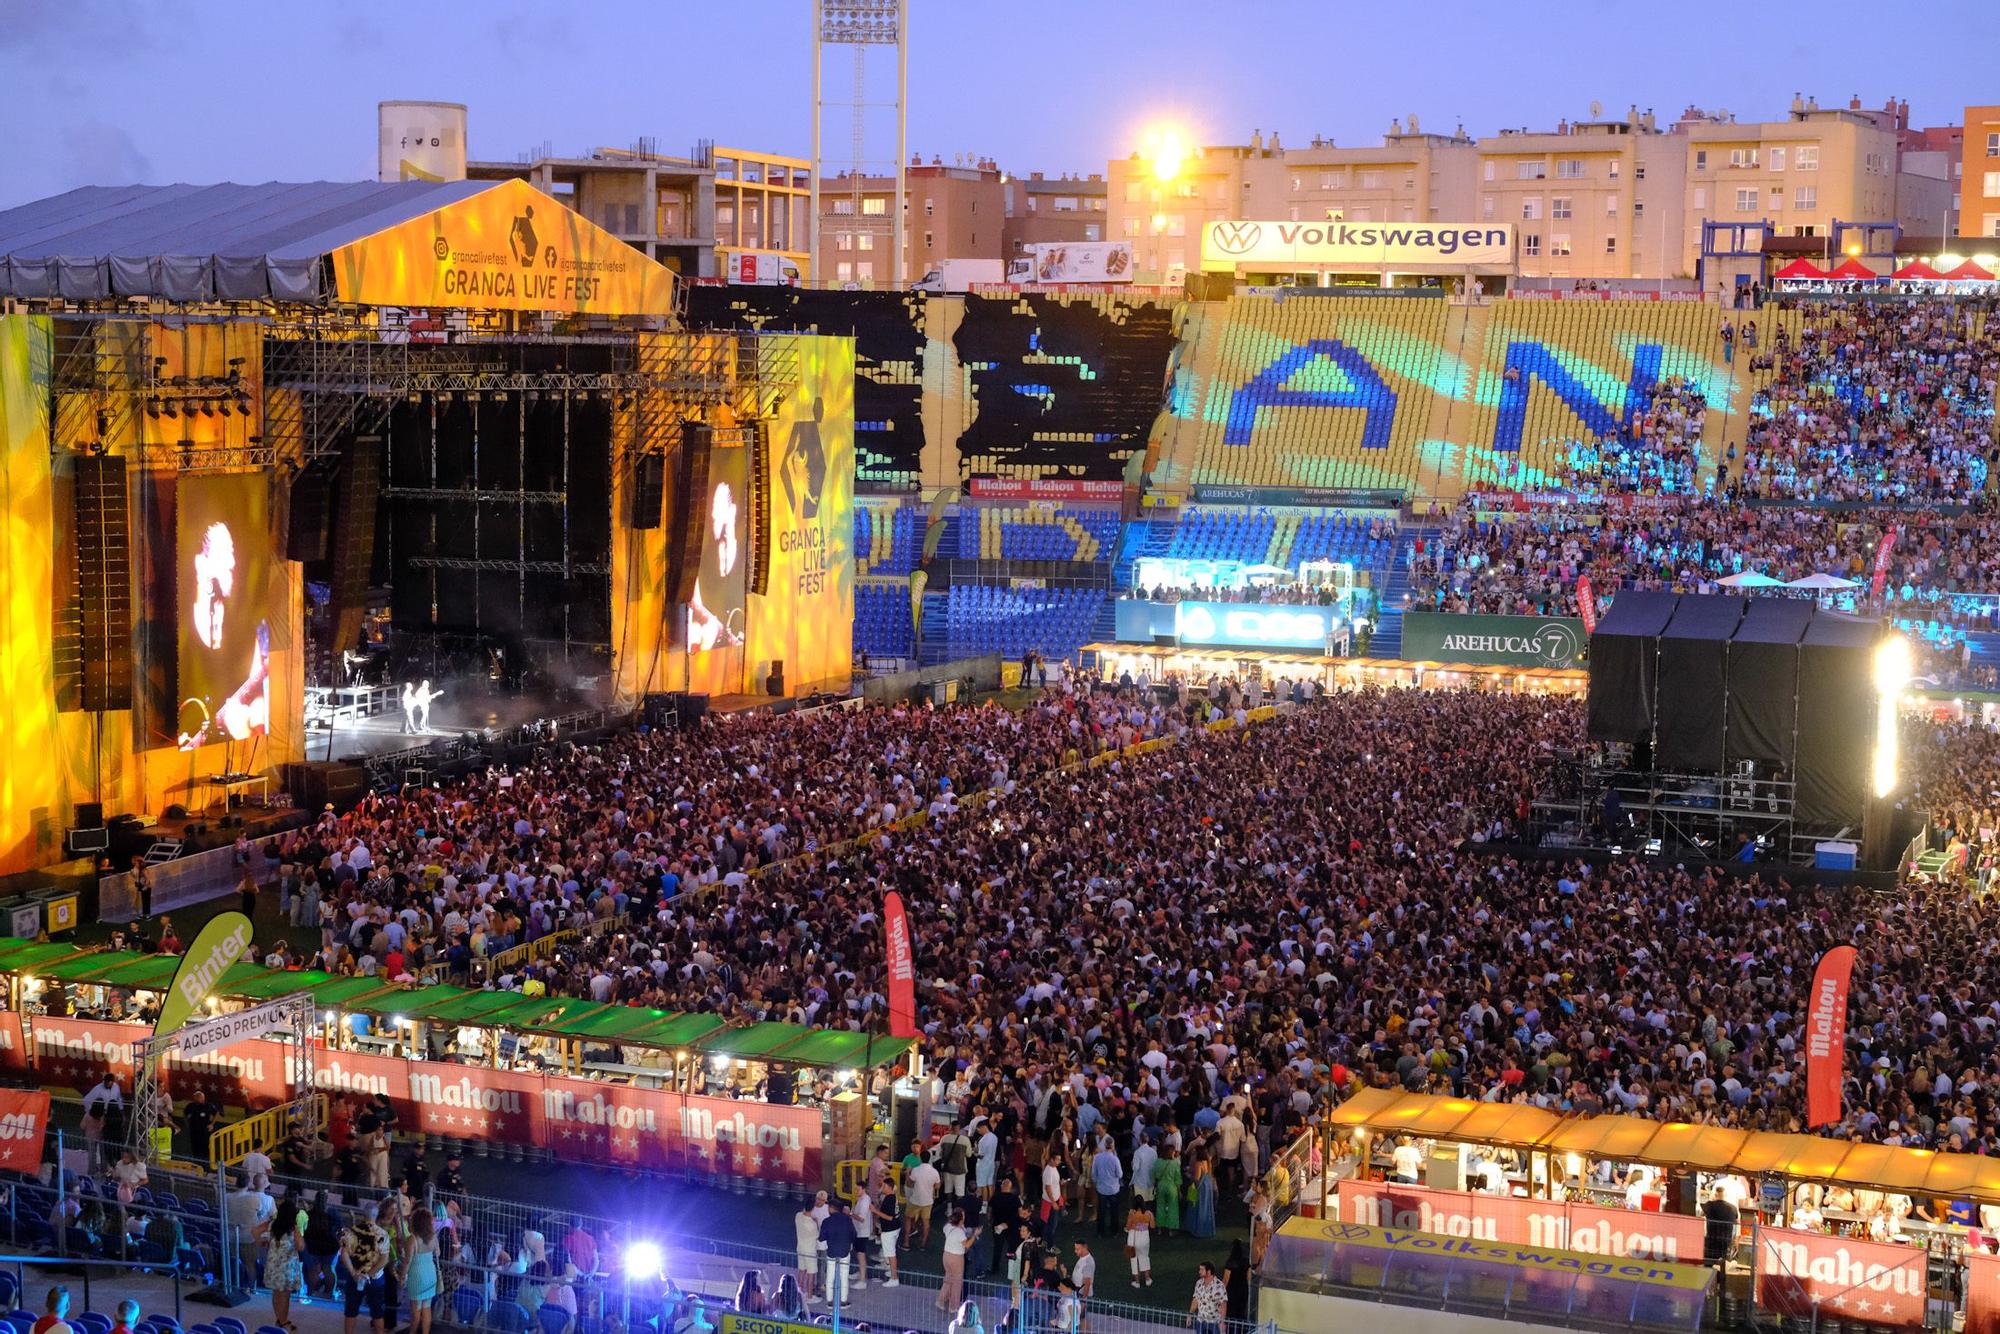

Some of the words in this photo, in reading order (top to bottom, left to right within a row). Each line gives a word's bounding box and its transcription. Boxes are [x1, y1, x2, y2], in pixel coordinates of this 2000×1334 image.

[1278, 224, 1506, 254] Volkswagen
[452, 251, 507, 266] grancalivefest
[445, 269, 516, 298] GRANCA
[524, 274, 557, 299] LIVE
[565, 276, 600, 301] FEST
[978, 480, 1022, 491] Mahou
[1030, 480, 1074, 492] Mahou
[1201, 490, 1245, 498] AREHUCAS
[779, 527, 826, 553] GRANCA
[803, 549, 826, 572] LIVE
[798, 572, 826, 597] FEST
[1441, 634, 1542, 654] AREHUCAS
[1547, 634, 1563, 658] 7
[893, 915, 912, 980] Mahou
[179, 923, 245, 1008] Binter
[1810, 978, 1837, 1057] Mahou
[35, 1027, 141, 1066] Mahou
[184, 1024, 232, 1051] ACCESO
[409, 1071, 522, 1115] Mahou
[542, 1087, 657, 1133] Mahou
[678, 1105, 802, 1151] Mahou
[1351, 1193, 1499, 1242] Mahou
[1526, 1212, 1679, 1263] Mahou
[1384, 1231, 1676, 1282] Volkswagen
[1763, 1238, 1922, 1297] Mahou
[735, 1318, 784, 1334] SECTOR
